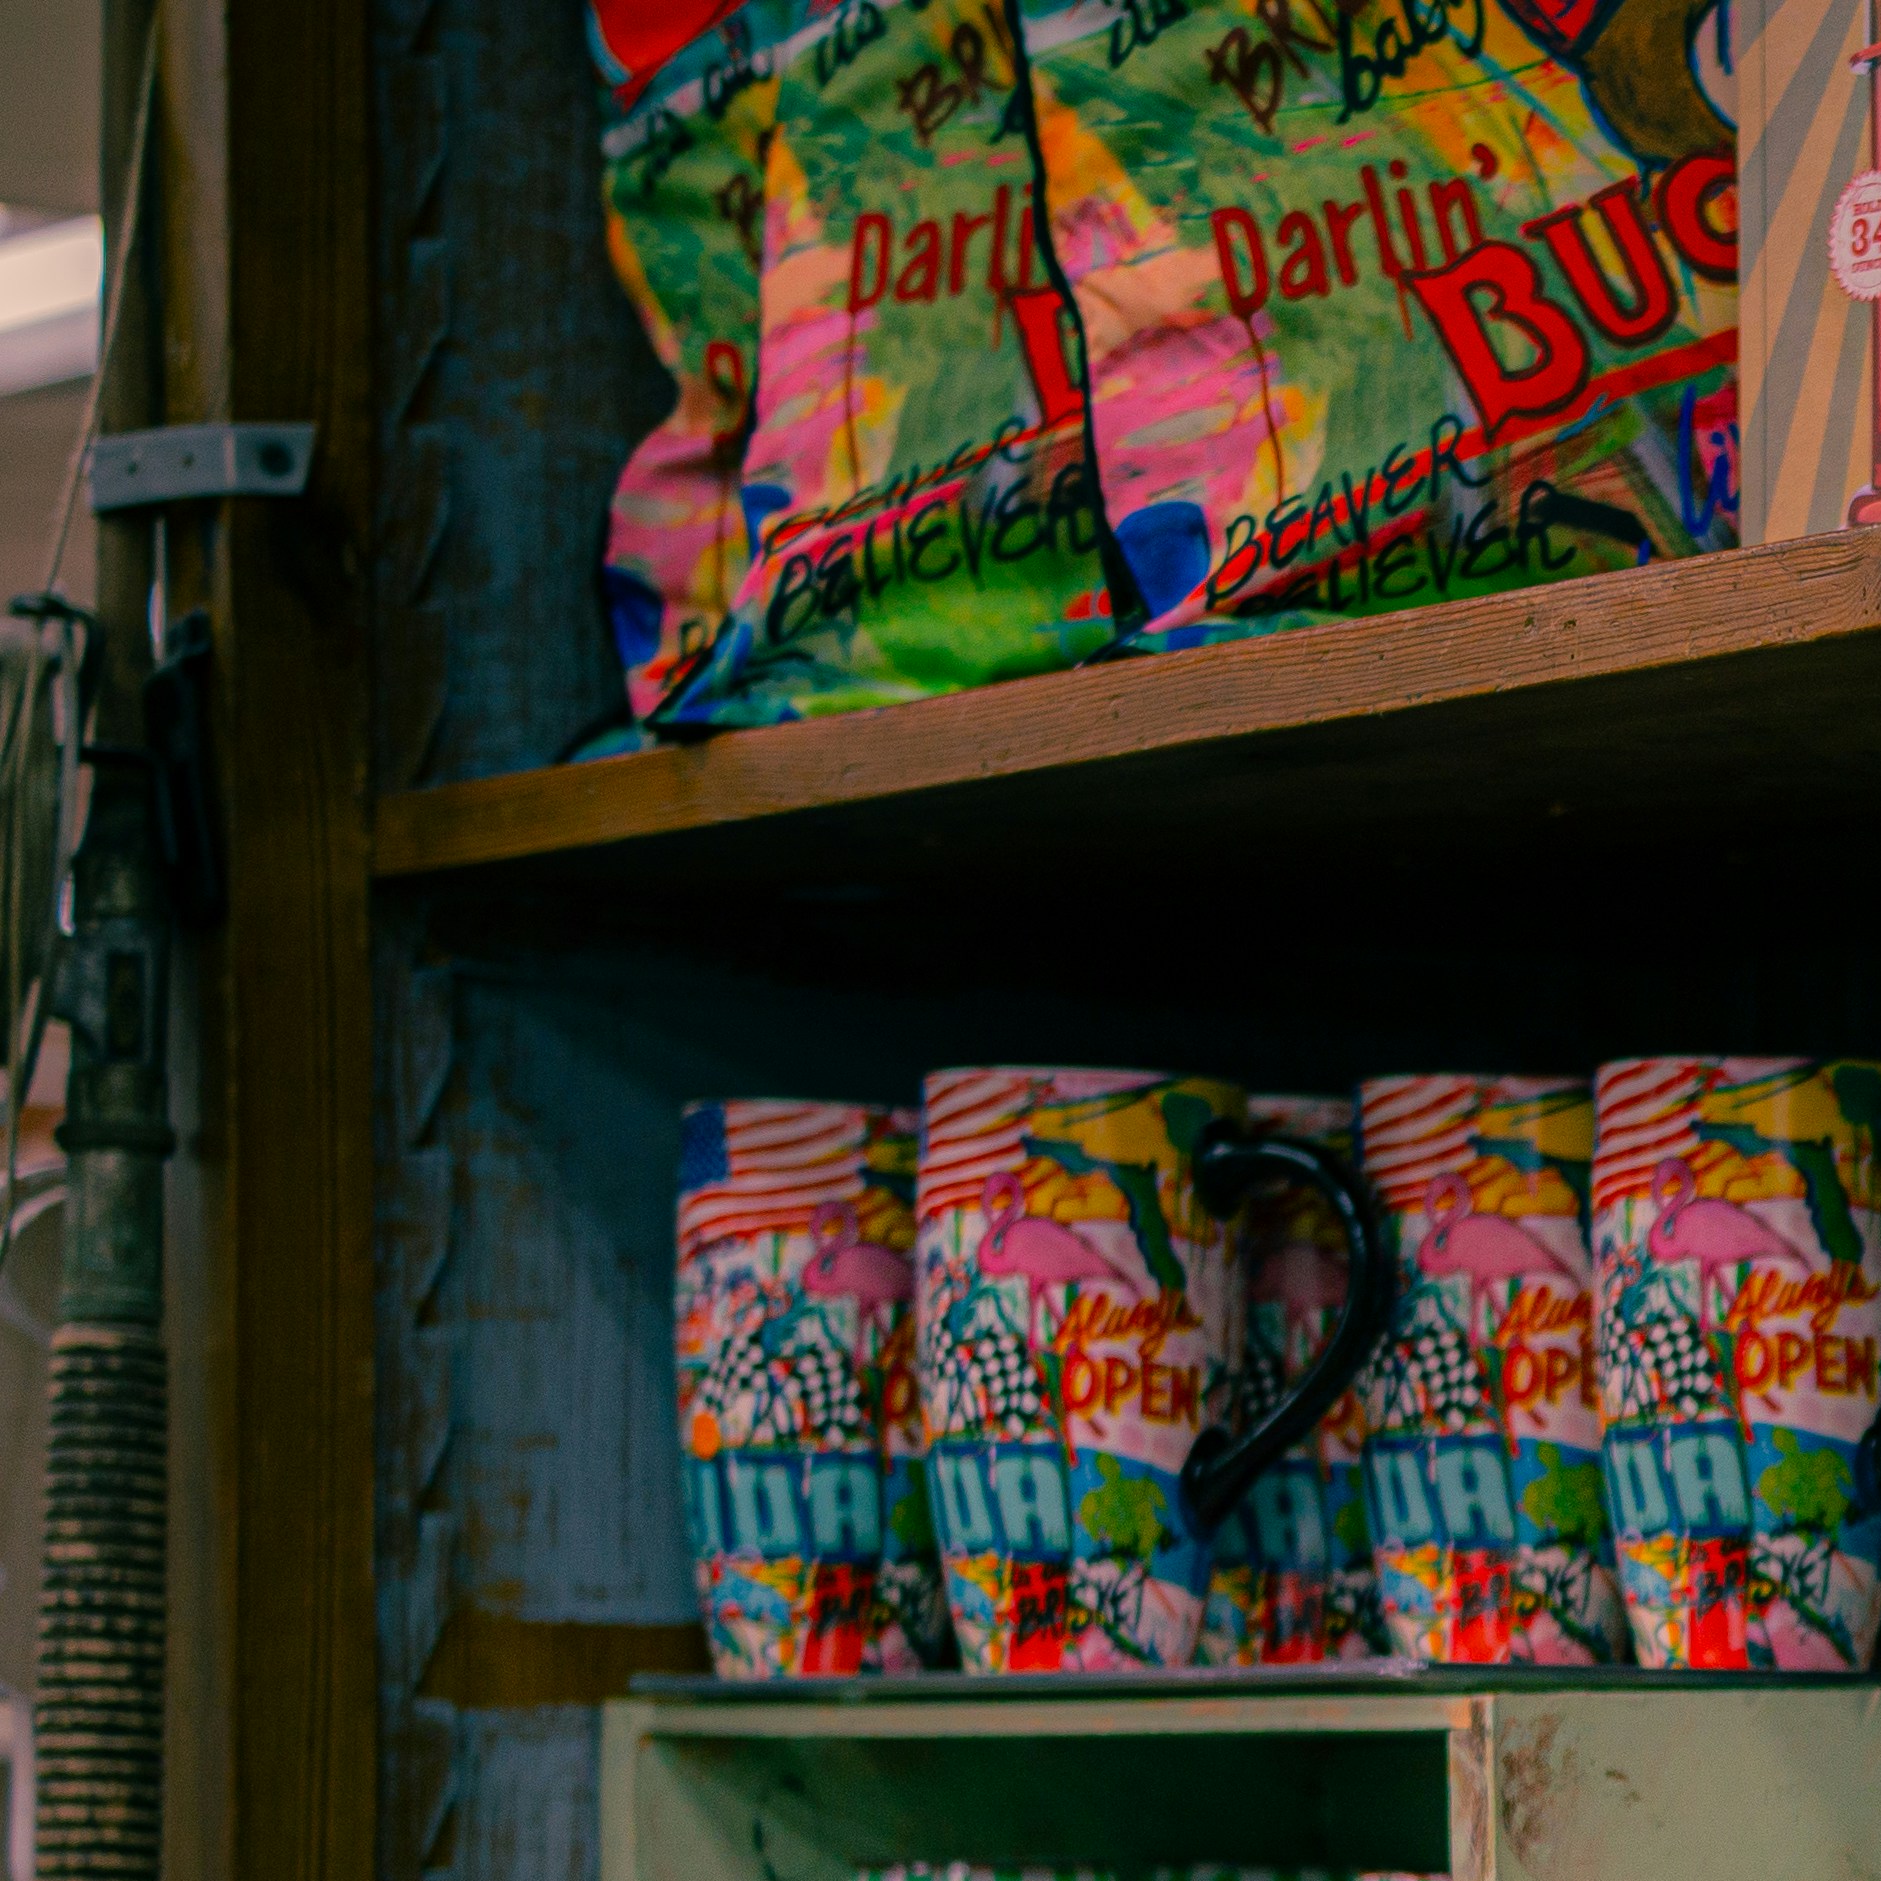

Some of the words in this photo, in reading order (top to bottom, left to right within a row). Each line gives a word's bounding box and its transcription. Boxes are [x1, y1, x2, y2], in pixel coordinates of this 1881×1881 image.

[1210, 142, 1500, 318] Darlin'
[1206, 414, 1494, 604] BEAVER
[1726, 1258, 1881, 1331] Always
[1062, 1350, 1200, 1426] OPEN
[1736, 1328, 1877, 1399] OPEN
